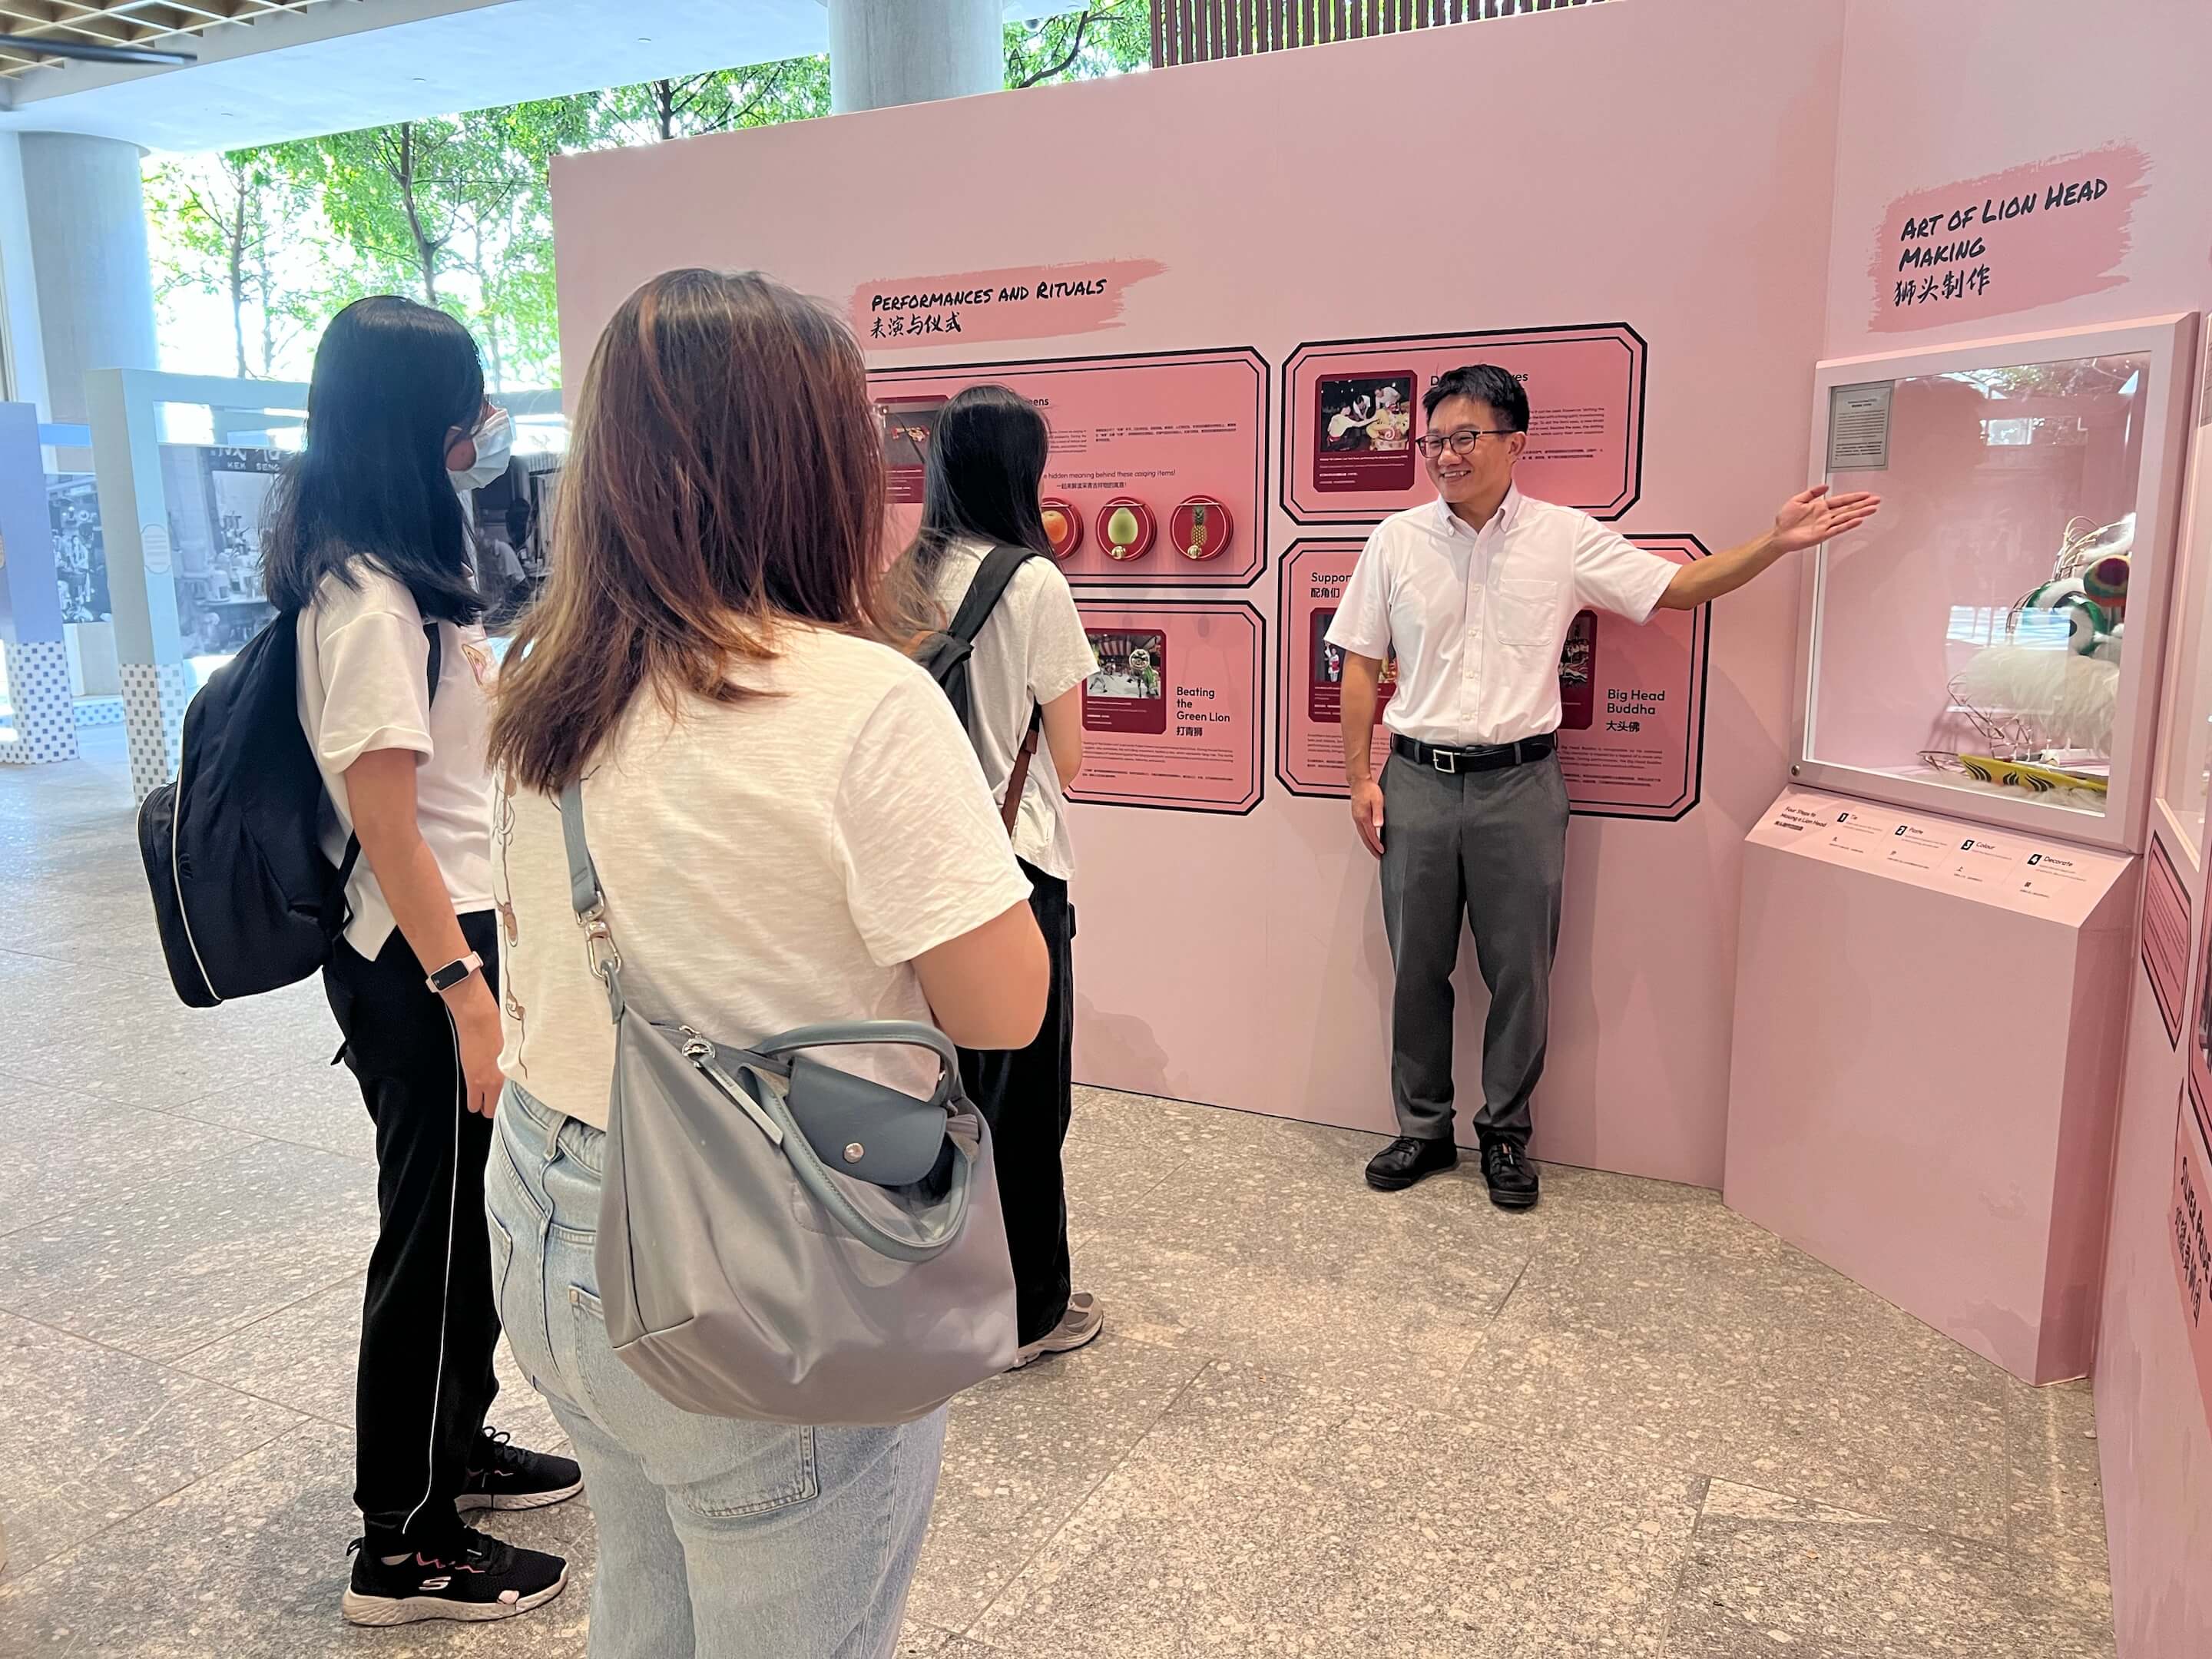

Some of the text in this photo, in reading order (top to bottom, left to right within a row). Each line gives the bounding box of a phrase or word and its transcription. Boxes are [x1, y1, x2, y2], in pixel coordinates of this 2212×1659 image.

[1900, 178, 2108, 241] ART OF LION HEAD
[1899, 237, 1986, 272] MAKING
[1893, 263, 1991, 307] 狮头制作
[871, 278, 1108, 312] PERFORMANCES AND RITUALS
[869, 310, 962, 339] 表演与仪式
[1310, 571, 1354, 584] Suppor
[1176, 686, 1215, 700] Beating
[1608, 688, 1665, 703] Big Head
[1176, 697, 1193, 708] the
[1607, 702, 1656, 715] Buddha
[1176, 710, 1230, 723] Green Lion
[1176, 725, 1204, 737] 打青狮
[1605, 720, 1641, 733] 大头佛
[1975, 841, 1996, 850] Colour
[2043, 856, 2074, 867] Decorate
